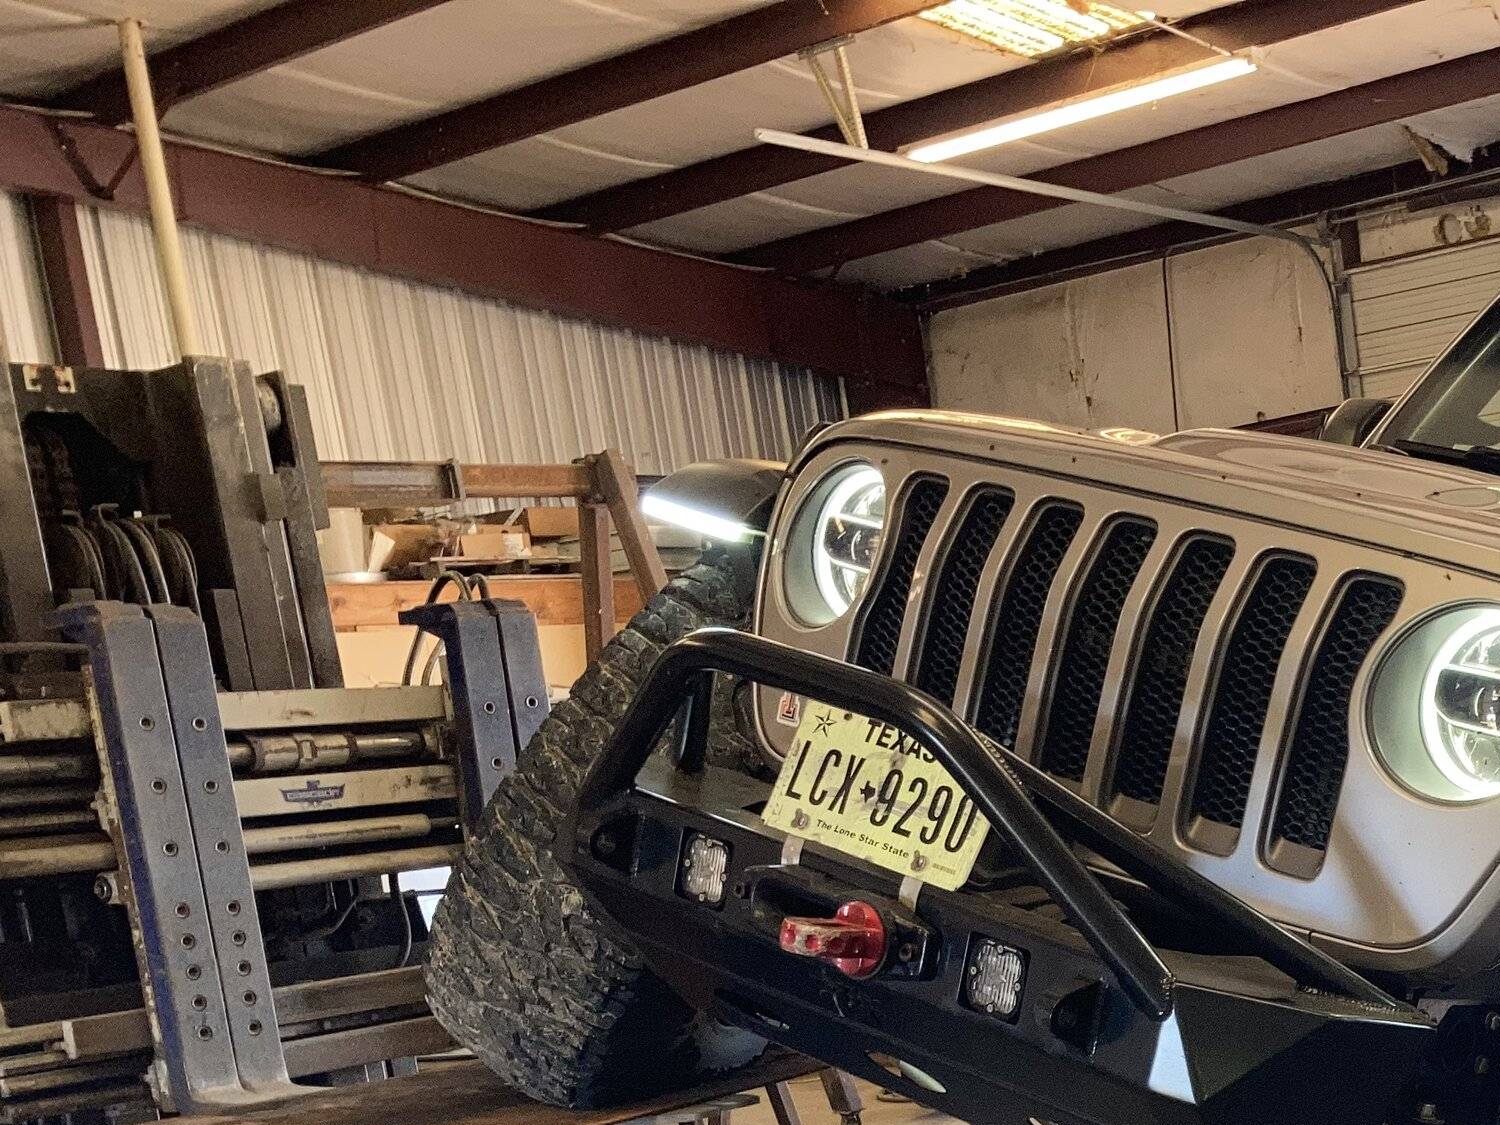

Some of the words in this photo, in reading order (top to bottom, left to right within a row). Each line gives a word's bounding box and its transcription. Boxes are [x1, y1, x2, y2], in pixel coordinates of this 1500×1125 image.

[785, 740, 866, 815] LCX
[869, 768, 978, 853] 9290
[817, 819, 832, 831] The
[834, 824, 856, 838] Lone
[858, 833, 880, 848] Star
[881, 842, 910, 859] State
